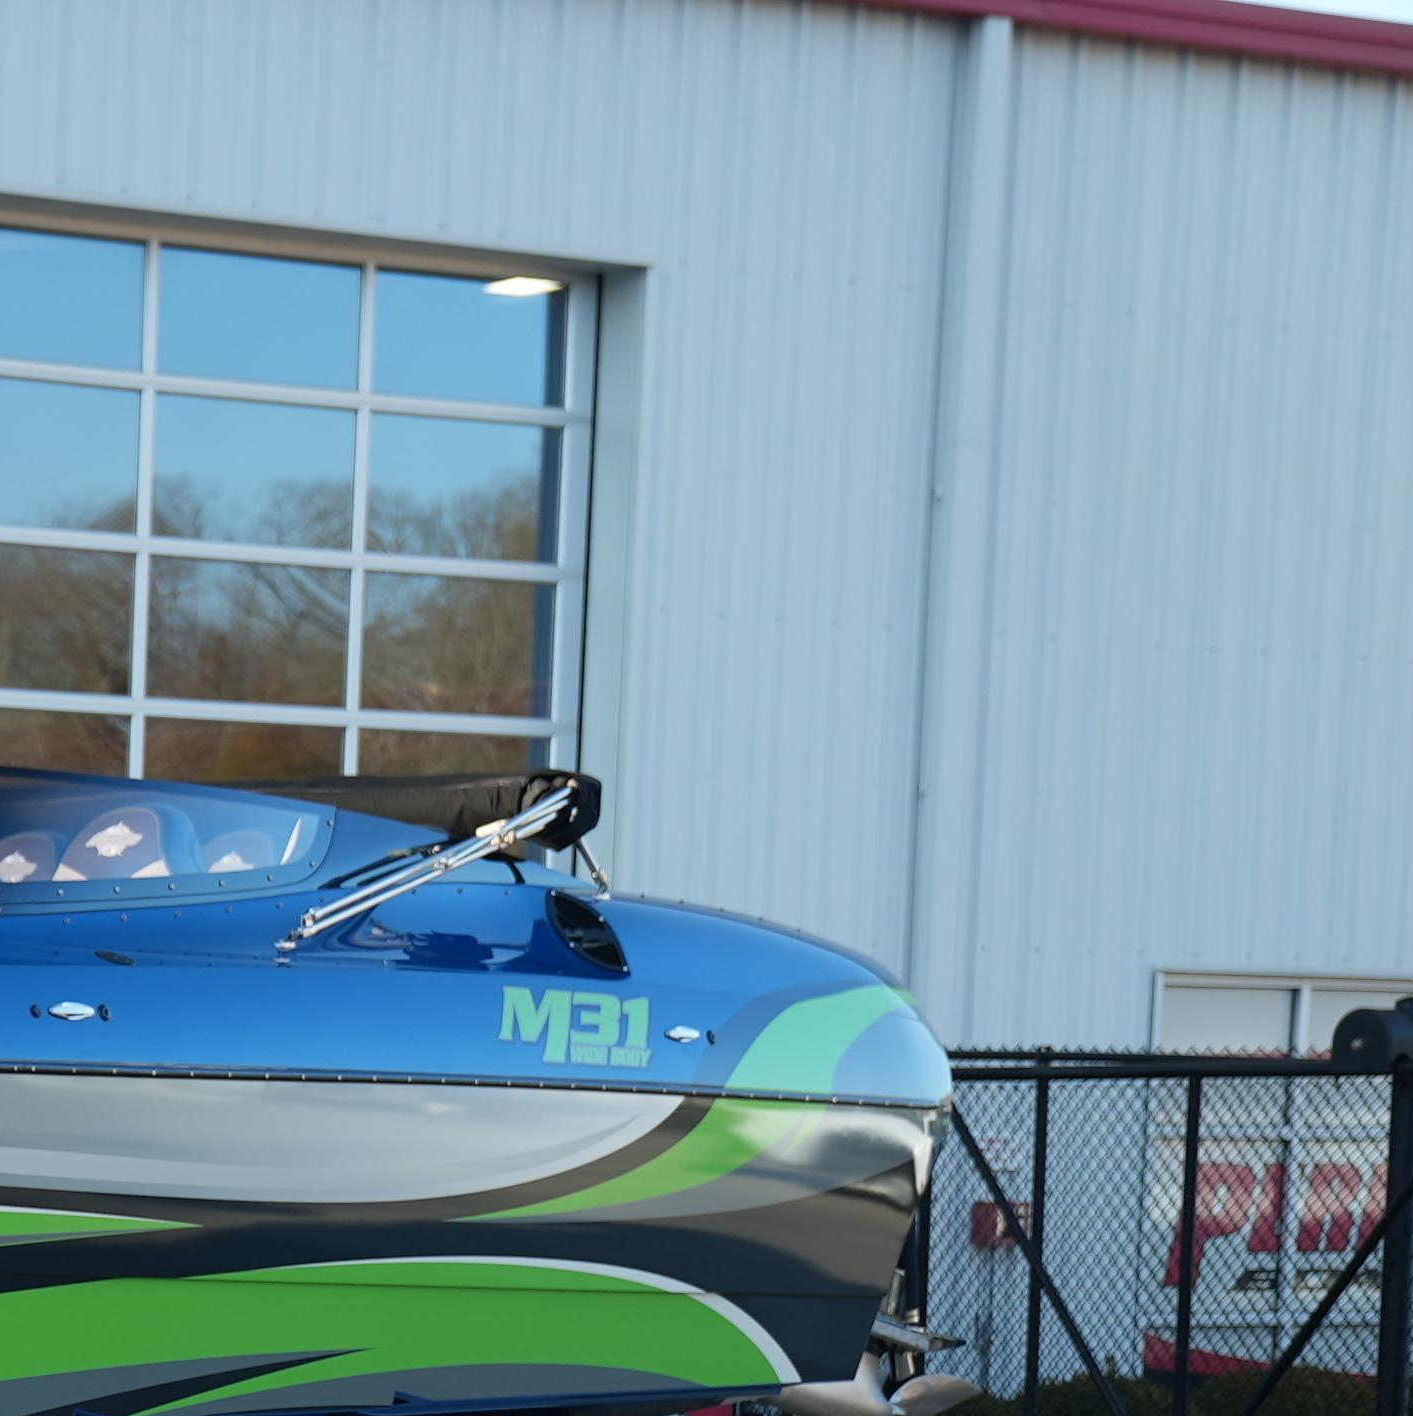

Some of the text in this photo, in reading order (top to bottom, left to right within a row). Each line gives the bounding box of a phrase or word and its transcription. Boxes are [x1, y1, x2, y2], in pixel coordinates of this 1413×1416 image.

[498, 985, 649, 1063] M31
[570, 1045, 652, 1068] WIDE BODY
